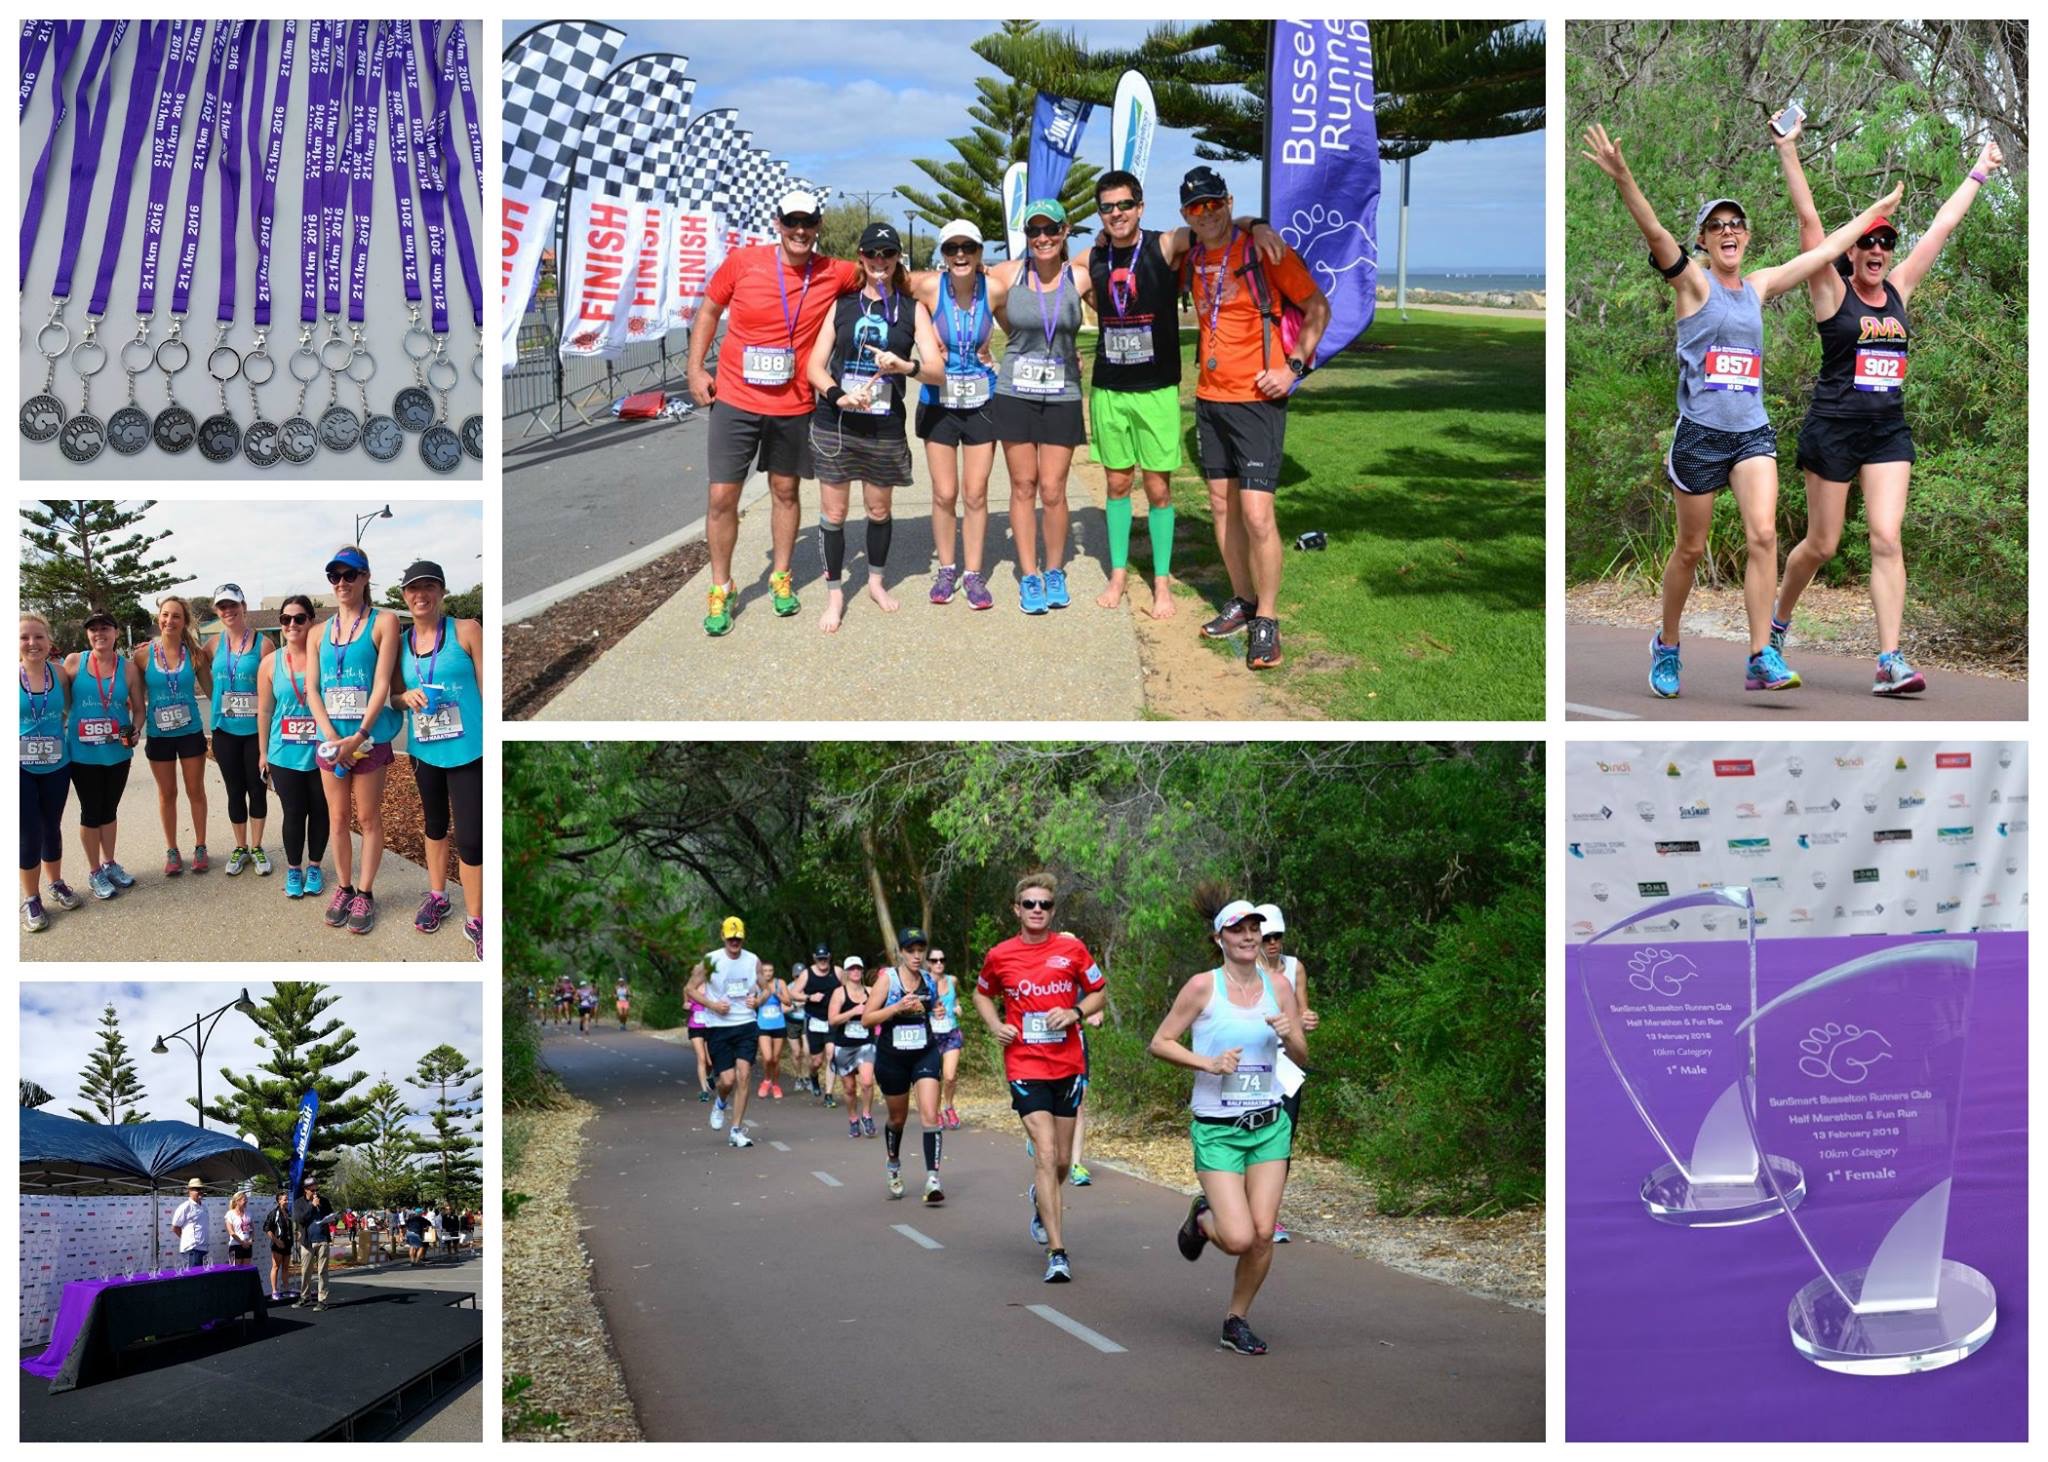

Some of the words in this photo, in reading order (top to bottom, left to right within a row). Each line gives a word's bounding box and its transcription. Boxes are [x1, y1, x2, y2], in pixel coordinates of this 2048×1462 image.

[23, 19, 38, 37] 016
[170, 35, 182, 61] 2016
[186, 27, 203, 63] 21.1km
[228, 45, 239, 70] 2016
[281, 40, 294, 77] 21.1km
[319, 37, 331, 74] 21.1km
[372, 40, 385, 78] 21.1km
[356, 49, 367, 77] 2016
[406, 50, 418, 89] 21.1km
[20, 72, 36, 98] 2016
[458, 65, 471, 92] 2016
[1282, 19, 1317, 166] Bussel
[1320, 19, 1352, 151] Runne
[156, 91, 172, 130] 21.1km
[314, 104, 325, 131] 2016
[392, 91, 404, 117] 2016
[162, 124, 179, 169] 21.1km
[172, 92, 186, 119] 2016
[221, 101, 232, 139] 21.1km
[326, 99, 339, 138] 21.1km
[354, 105, 364, 145] 21.1km
[368, 106, 378, 134] 2016
[412, 118, 424, 144] 2016
[193, 127, 209, 170] 21.1km
[265, 140, 280, 183] 21.1km
[273, 106, 285, 134] 2016
[396, 123, 407, 163] 21.1km
[468, 122, 482, 163] 21.1km
[311, 136, 323, 179] 21.1km
[324, 144, 336, 172] 2016
[362, 139, 376, 181] 21.1km
[417, 151, 432, 190] 21.1km
[150, 203, 164, 235] 2016
[332, 208, 344, 238] 2016
[401, 198, 412, 227] 2016
[261, 216, 272, 248] 2016
[306, 214, 318, 245] 2016
[428, 225, 441, 256] 2016
[178, 243, 196, 290] 21.1km
[188, 205, 199, 236] 2016
[352, 253, 366, 300] 21.1km
[359, 215, 370, 246] 2016
[405, 235, 417, 280] 21.1km
[679, 215, 707, 298] FINISH
[143, 242, 158, 290] 21.1km
[305, 251, 316, 299] 21.1km
[329, 244, 341, 292] 21.1km
[579, 203, 629, 322] FINISH
[259, 255, 270, 302] 21.1km
[432, 263, 446, 310] 21.1km
[1112, 335, 1141, 352] 104
[752, 355, 785, 371] 188
[1021, 364, 1056, 380] 375
[1715, 354, 1753, 376] 857
[1864, 358, 1899, 377] 902
[953, 382, 976, 396] 63
[231, 697, 250, 708] 211
[332, 692, 356, 707] 124
[84, 723, 113, 736] 968
[161, 709, 183, 722] 616
[288, 722, 315, 734] 822
[418, 710, 451, 728] 324
[27, 741, 54, 754] 615
[1031, 980, 1073, 996] bubble
[1648, 1004, 1684, 1012] Busselton
[1715, 1003, 1732, 1011] Club
[900, 1030, 919, 1040] 107
[1626, 1019, 1643, 1027] Half
[1644, 1019, 1682, 1027] Marathon
[1692, 1018, 1706, 1026] Fun
[1653, 1047, 1675, 1057] 10km
[1676, 1047, 1713, 1058] Category
[1239, 1074, 1260, 1091] 74
[1680, 1064, 1708, 1075] Male
[1769, 1096, 1818, 1107] SunSmart
[1820, 1094, 1868, 1104] Busselton
[1869, 1092, 1909, 1101] Runners
[1910, 1090, 1933, 1100] Club
[1788, 1114, 1810, 1124] Half
[1812, 1112, 1863, 1122] Marathon
[1866, 1111, 1874, 1119] &
[1876, 1110, 1895, 1119] Fun
[1897, 1109, 1918, 1118] Run
[1813, 1131, 1826, 1140] 13
[1828, 1130, 1871, 1139] February
[1872, 1127, 1900, 1136] 2016
[1819, 1149, 1849, 1159] 10km
[1852, 1147, 1898, 1159] Category
[1845, 1167, 1897, 1181] Female
